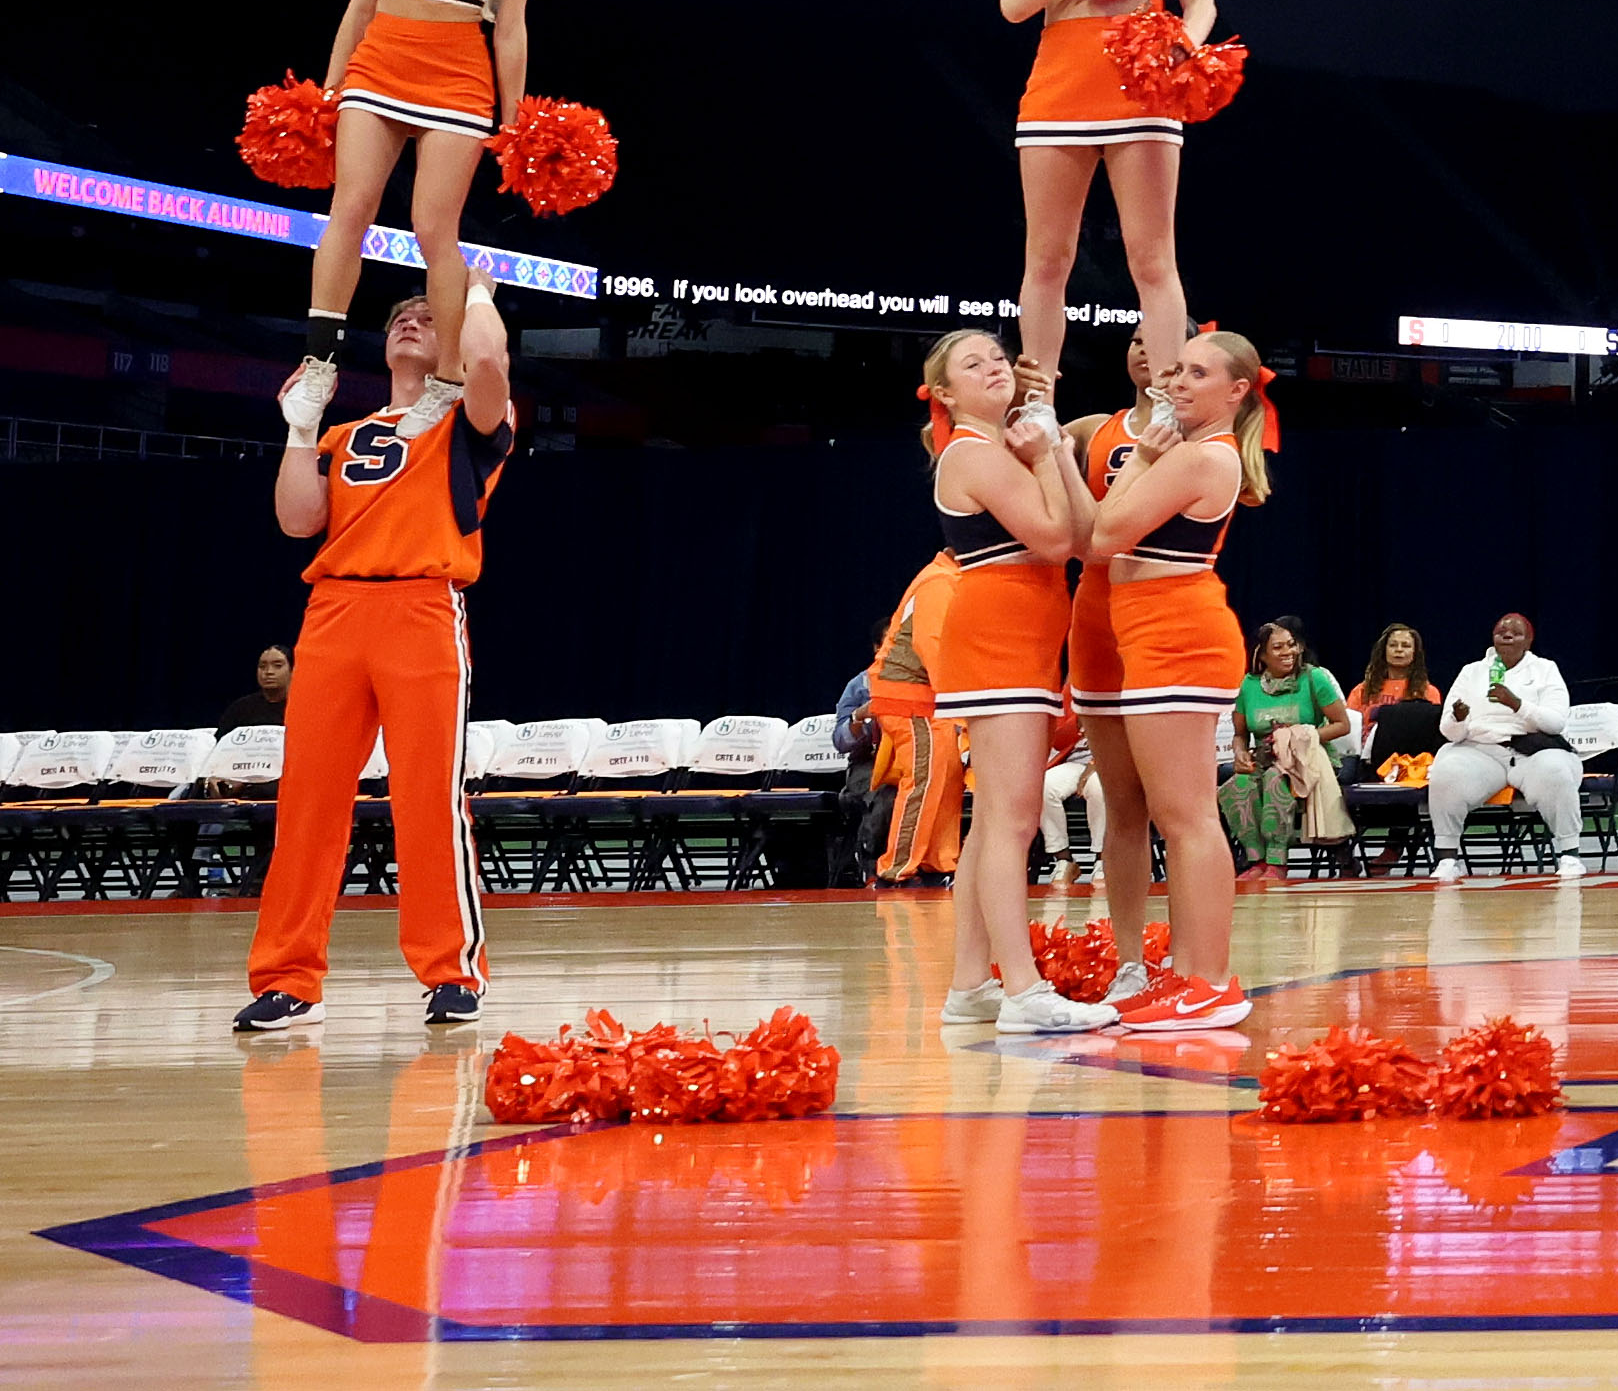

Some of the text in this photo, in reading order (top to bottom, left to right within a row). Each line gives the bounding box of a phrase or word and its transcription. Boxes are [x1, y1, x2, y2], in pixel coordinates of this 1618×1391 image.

[33, 167, 146, 212] WELCOME
[147, 190, 207, 223] BACK
[602, 275, 660, 298] 1996.
[673, 279, 689, 299] If
[691, 284, 730, 305] you
[735, 283, 778, 305] look
[781, 287, 875, 311] overhead
[879, 296, 915, 315] you
[918, 295, 950, 315] will
[958, 299, 994, 318] see
[1408, 319, 1425, 345] S
[341, 420, 408, 487] S
[715, 754, 733, 762] CRTE
[804, 753, 823, 761] CRTE
